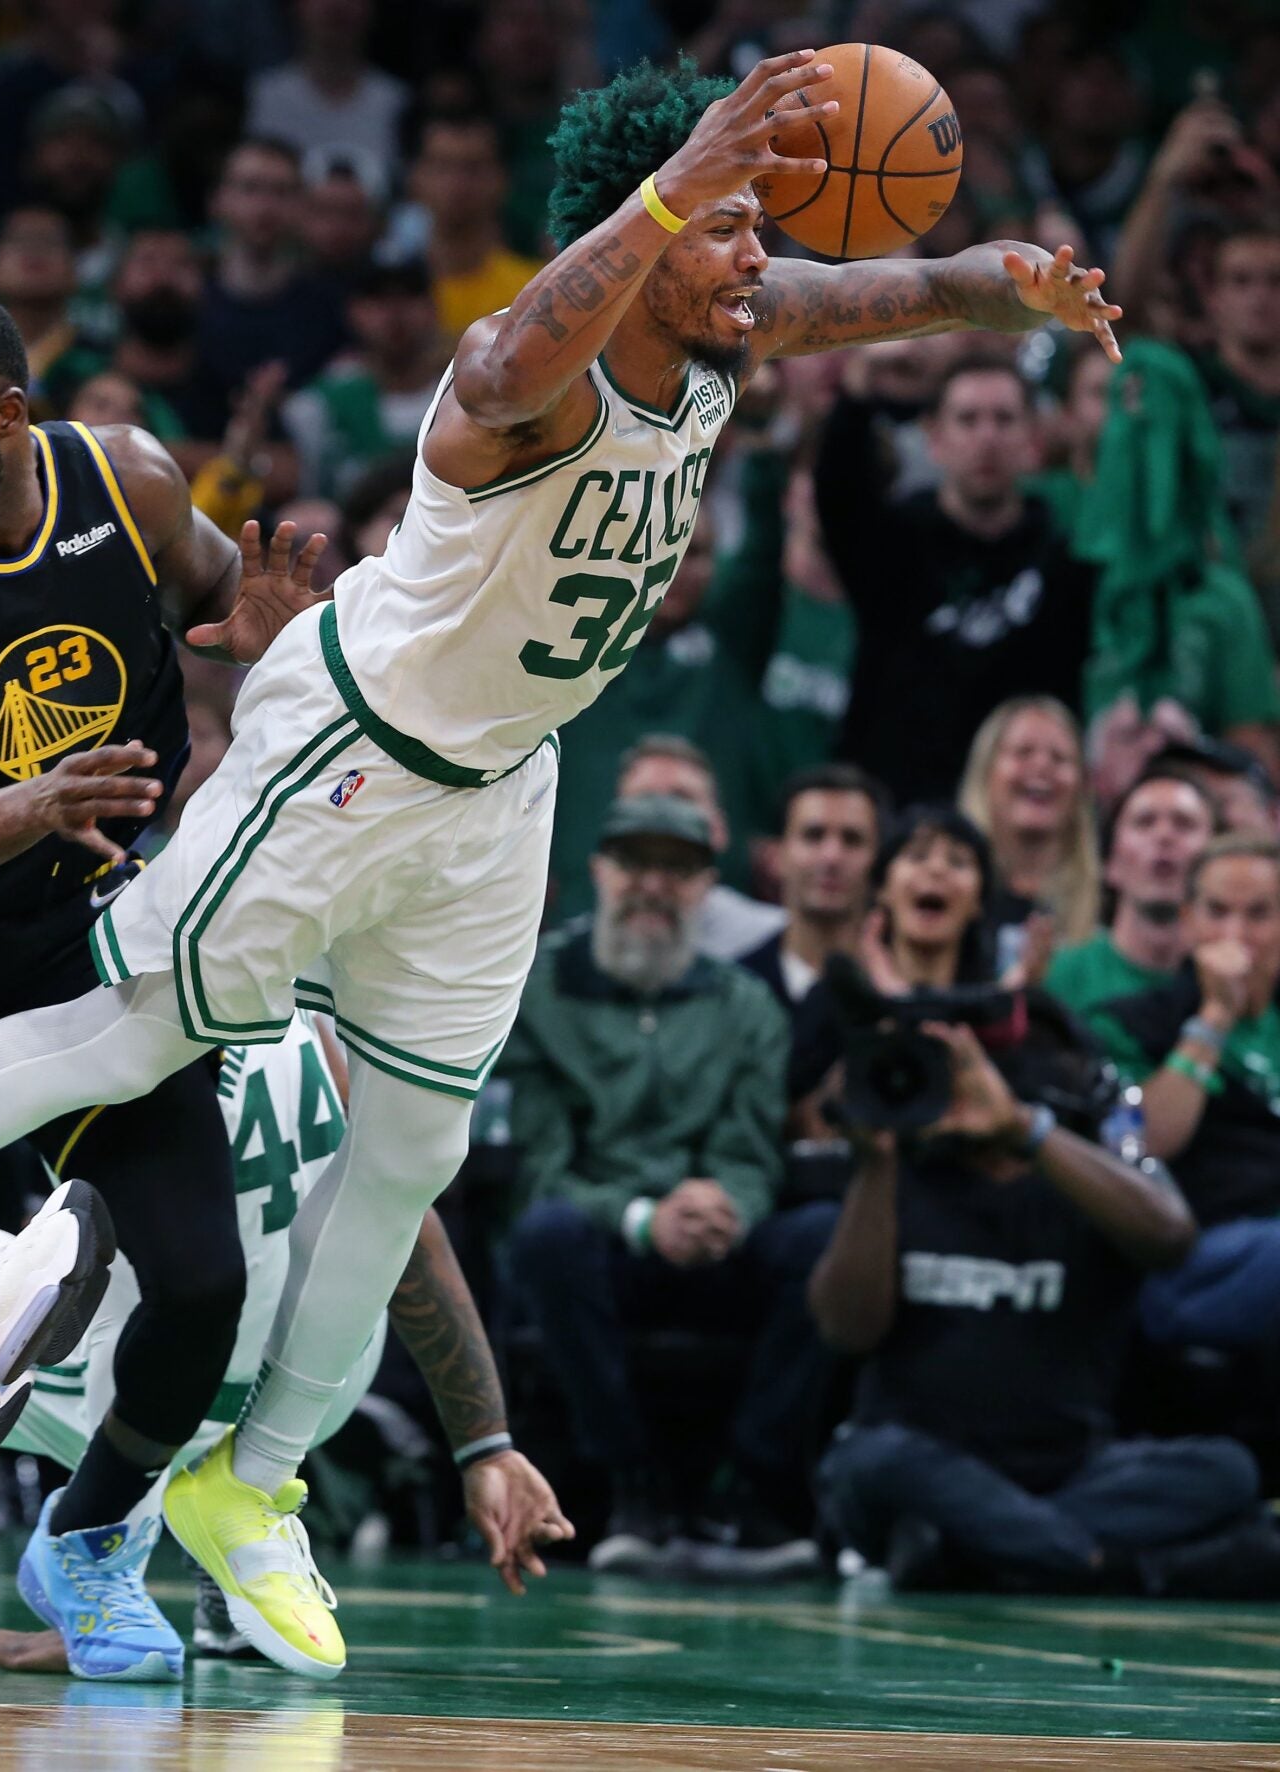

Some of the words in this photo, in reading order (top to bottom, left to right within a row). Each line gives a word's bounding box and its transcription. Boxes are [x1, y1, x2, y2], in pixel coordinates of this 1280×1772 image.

[698, 400, 726, 430] PRINT
[55, 521, 117, 557] Rakuten
[25, 634, 92, 694] 23
